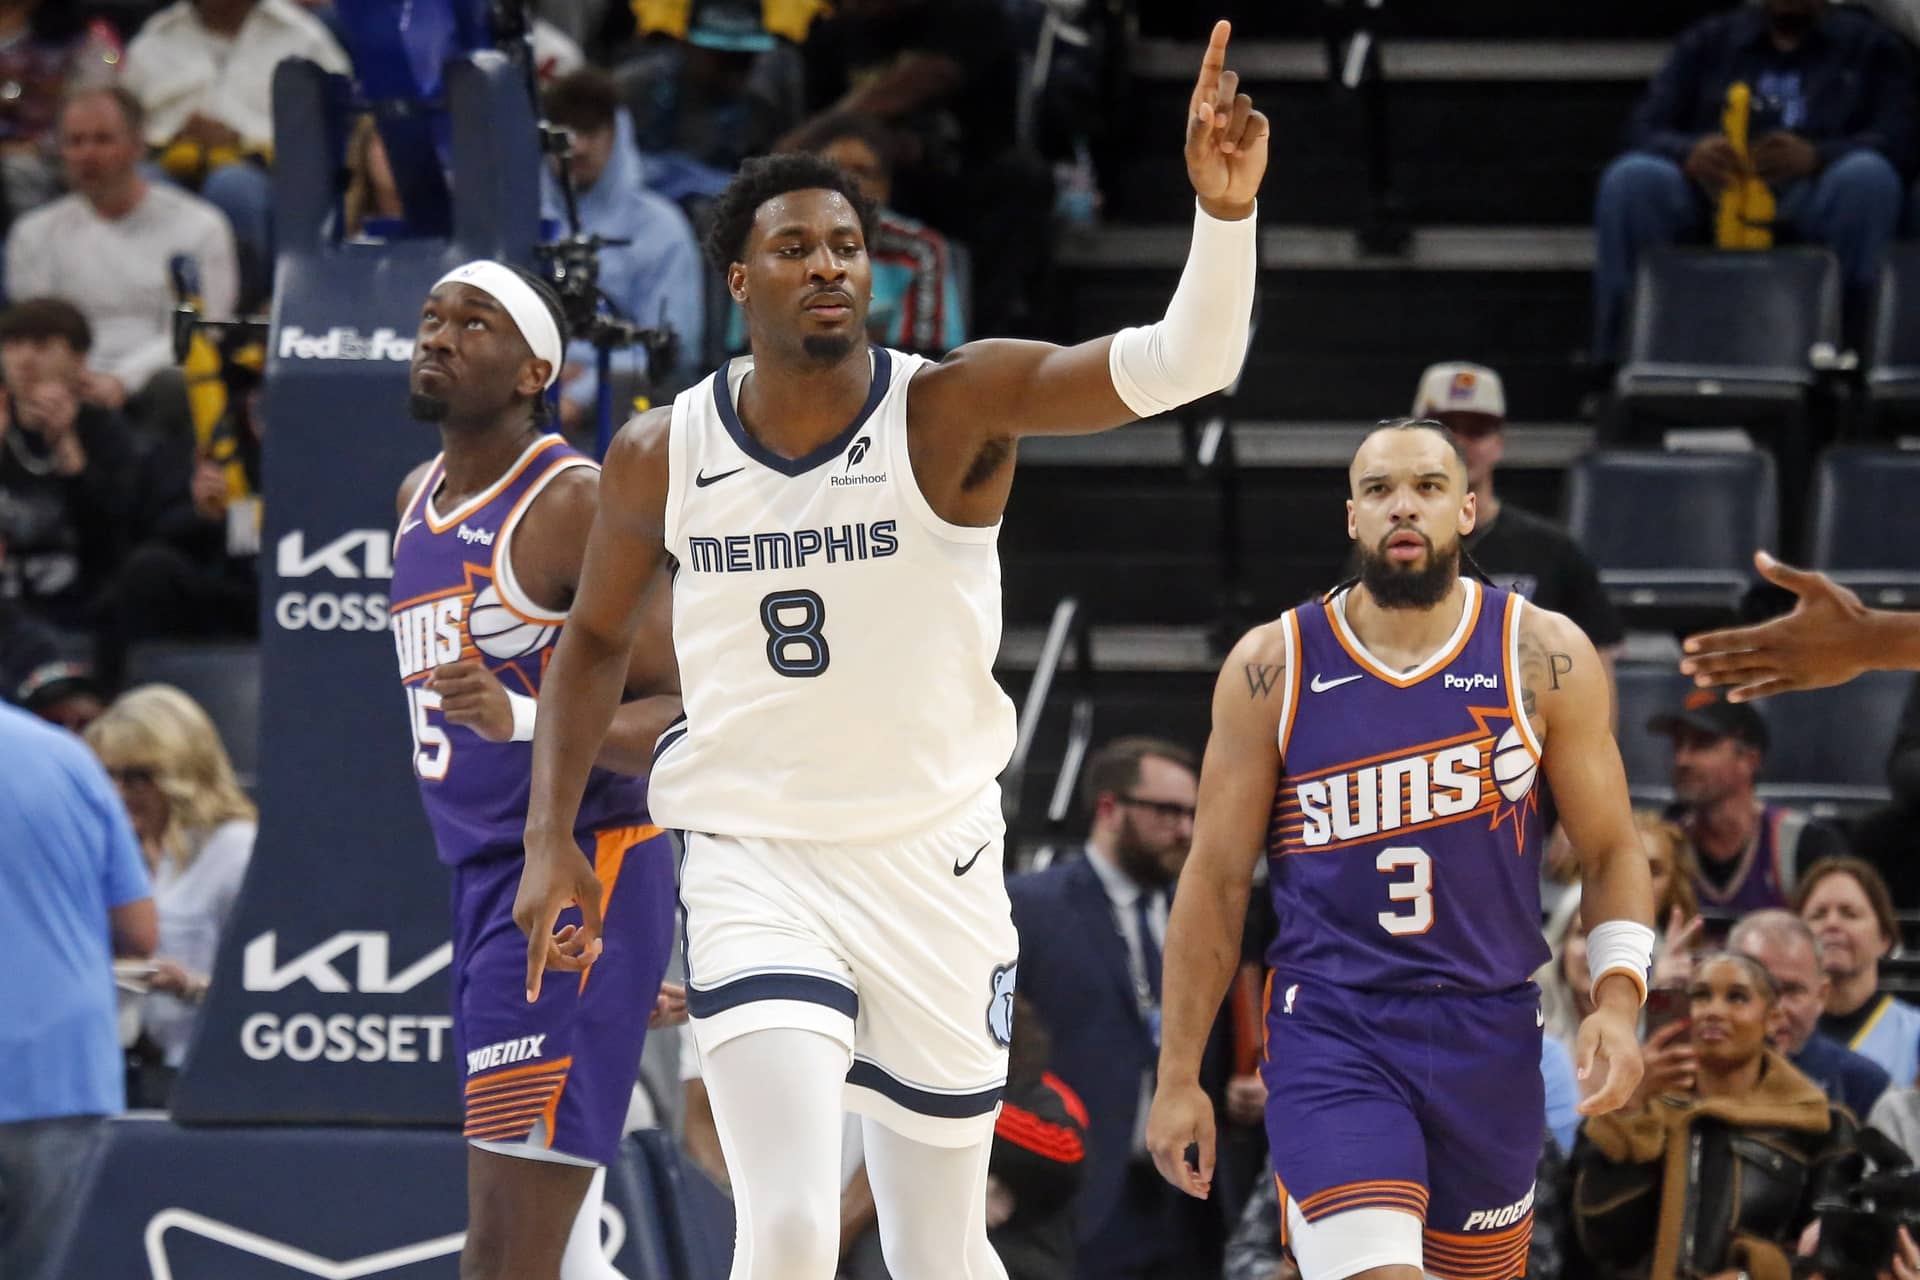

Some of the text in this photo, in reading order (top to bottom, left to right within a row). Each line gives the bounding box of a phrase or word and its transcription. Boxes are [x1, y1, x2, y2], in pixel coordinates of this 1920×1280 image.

[831, 473, 887, 487] Robinhood
[457, 524, 495, 546] PayPal
[689, 520, 898, 572] MEMPHIS
[275, 592, 394, 631] GOSS
[760, 589, 830, 678] 8
[1244, 663, 1287, 699] W
[1444, 674, 1498, 691] PayPal
[1546, 654, 1573, 690] P
[1296, 744, 1481, 846] SUNS
[1376, 847, 1434, 936] 3
